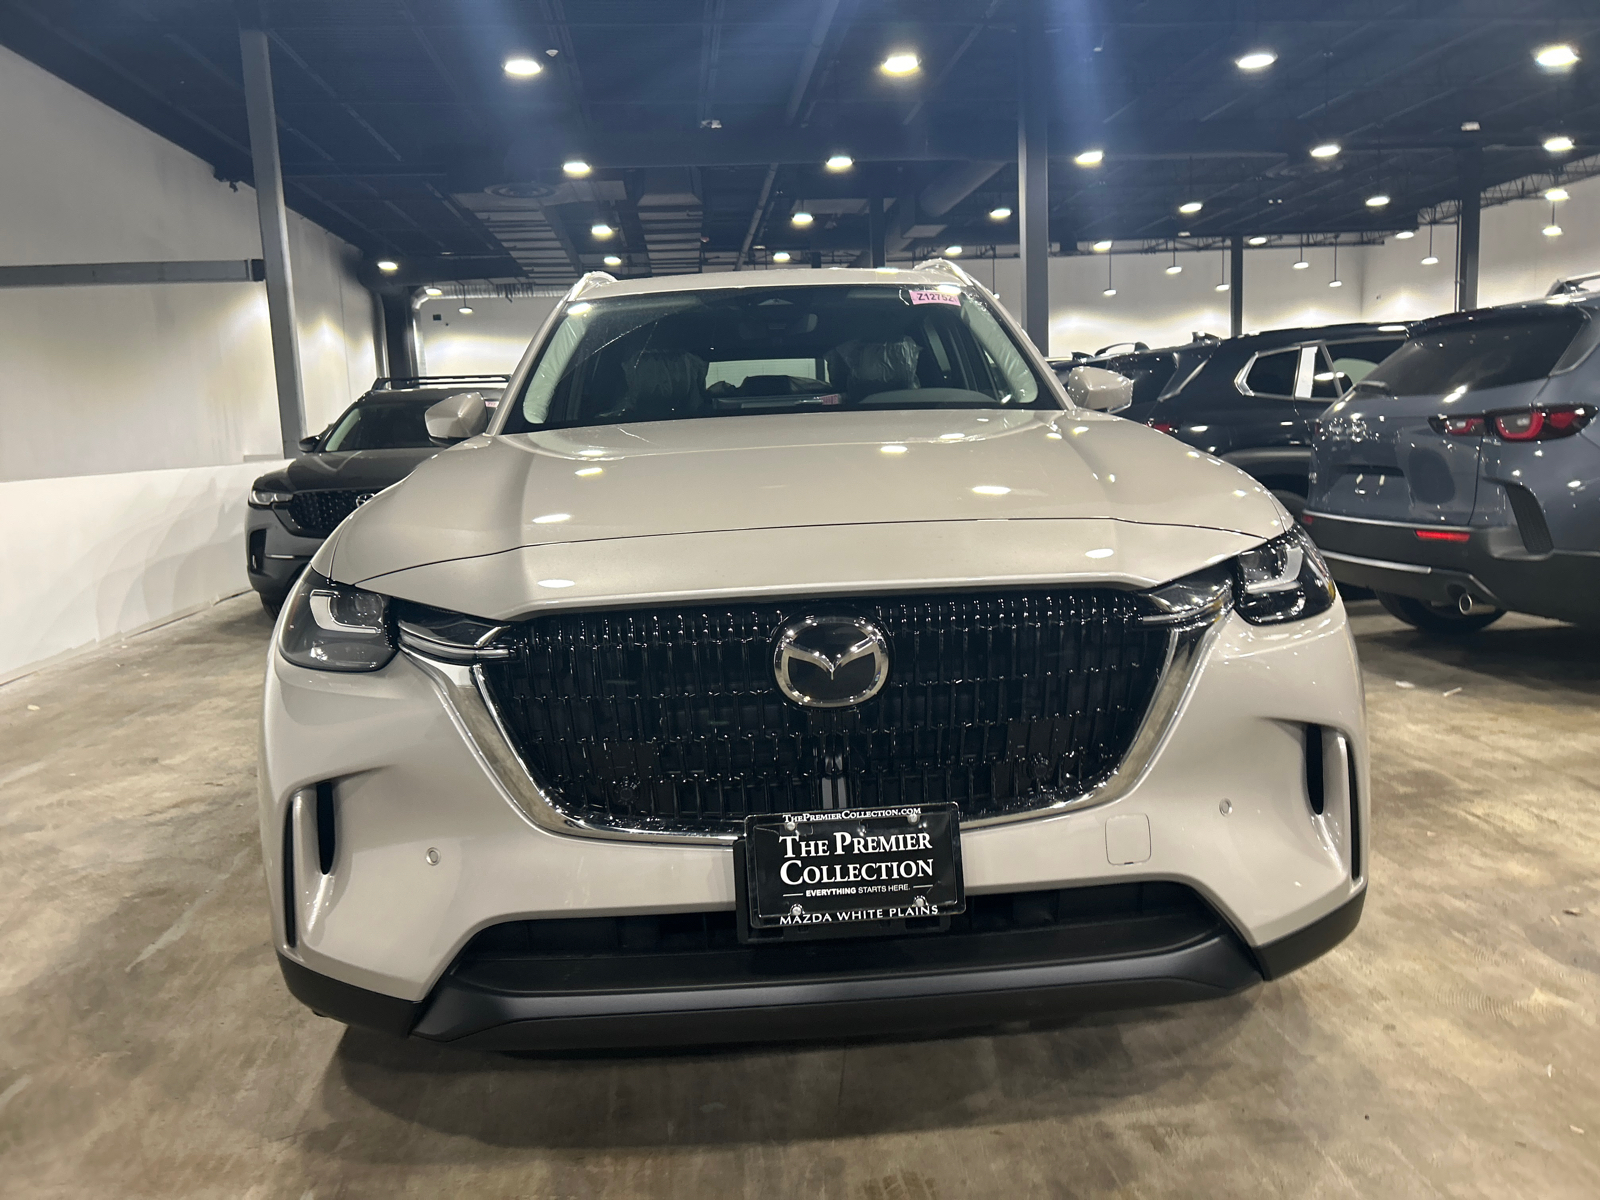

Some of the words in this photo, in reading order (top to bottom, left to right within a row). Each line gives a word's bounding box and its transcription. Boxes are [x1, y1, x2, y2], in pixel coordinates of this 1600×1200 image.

[779, 836, 829, 857] THE
[833, 832, 932, 855] PREMIER
[780, 858, 934, 885] COLLECTION
[806, 887, 856, 897] EVERYTHING
[858, 884, 887, 894] STARTS
[888, 883, 911, 892] HERE.
[780, 913, 832, 925] MAZDA
[836, 909, 884, 921] WHITE
[889, 904, 939, 917] PLAINS
